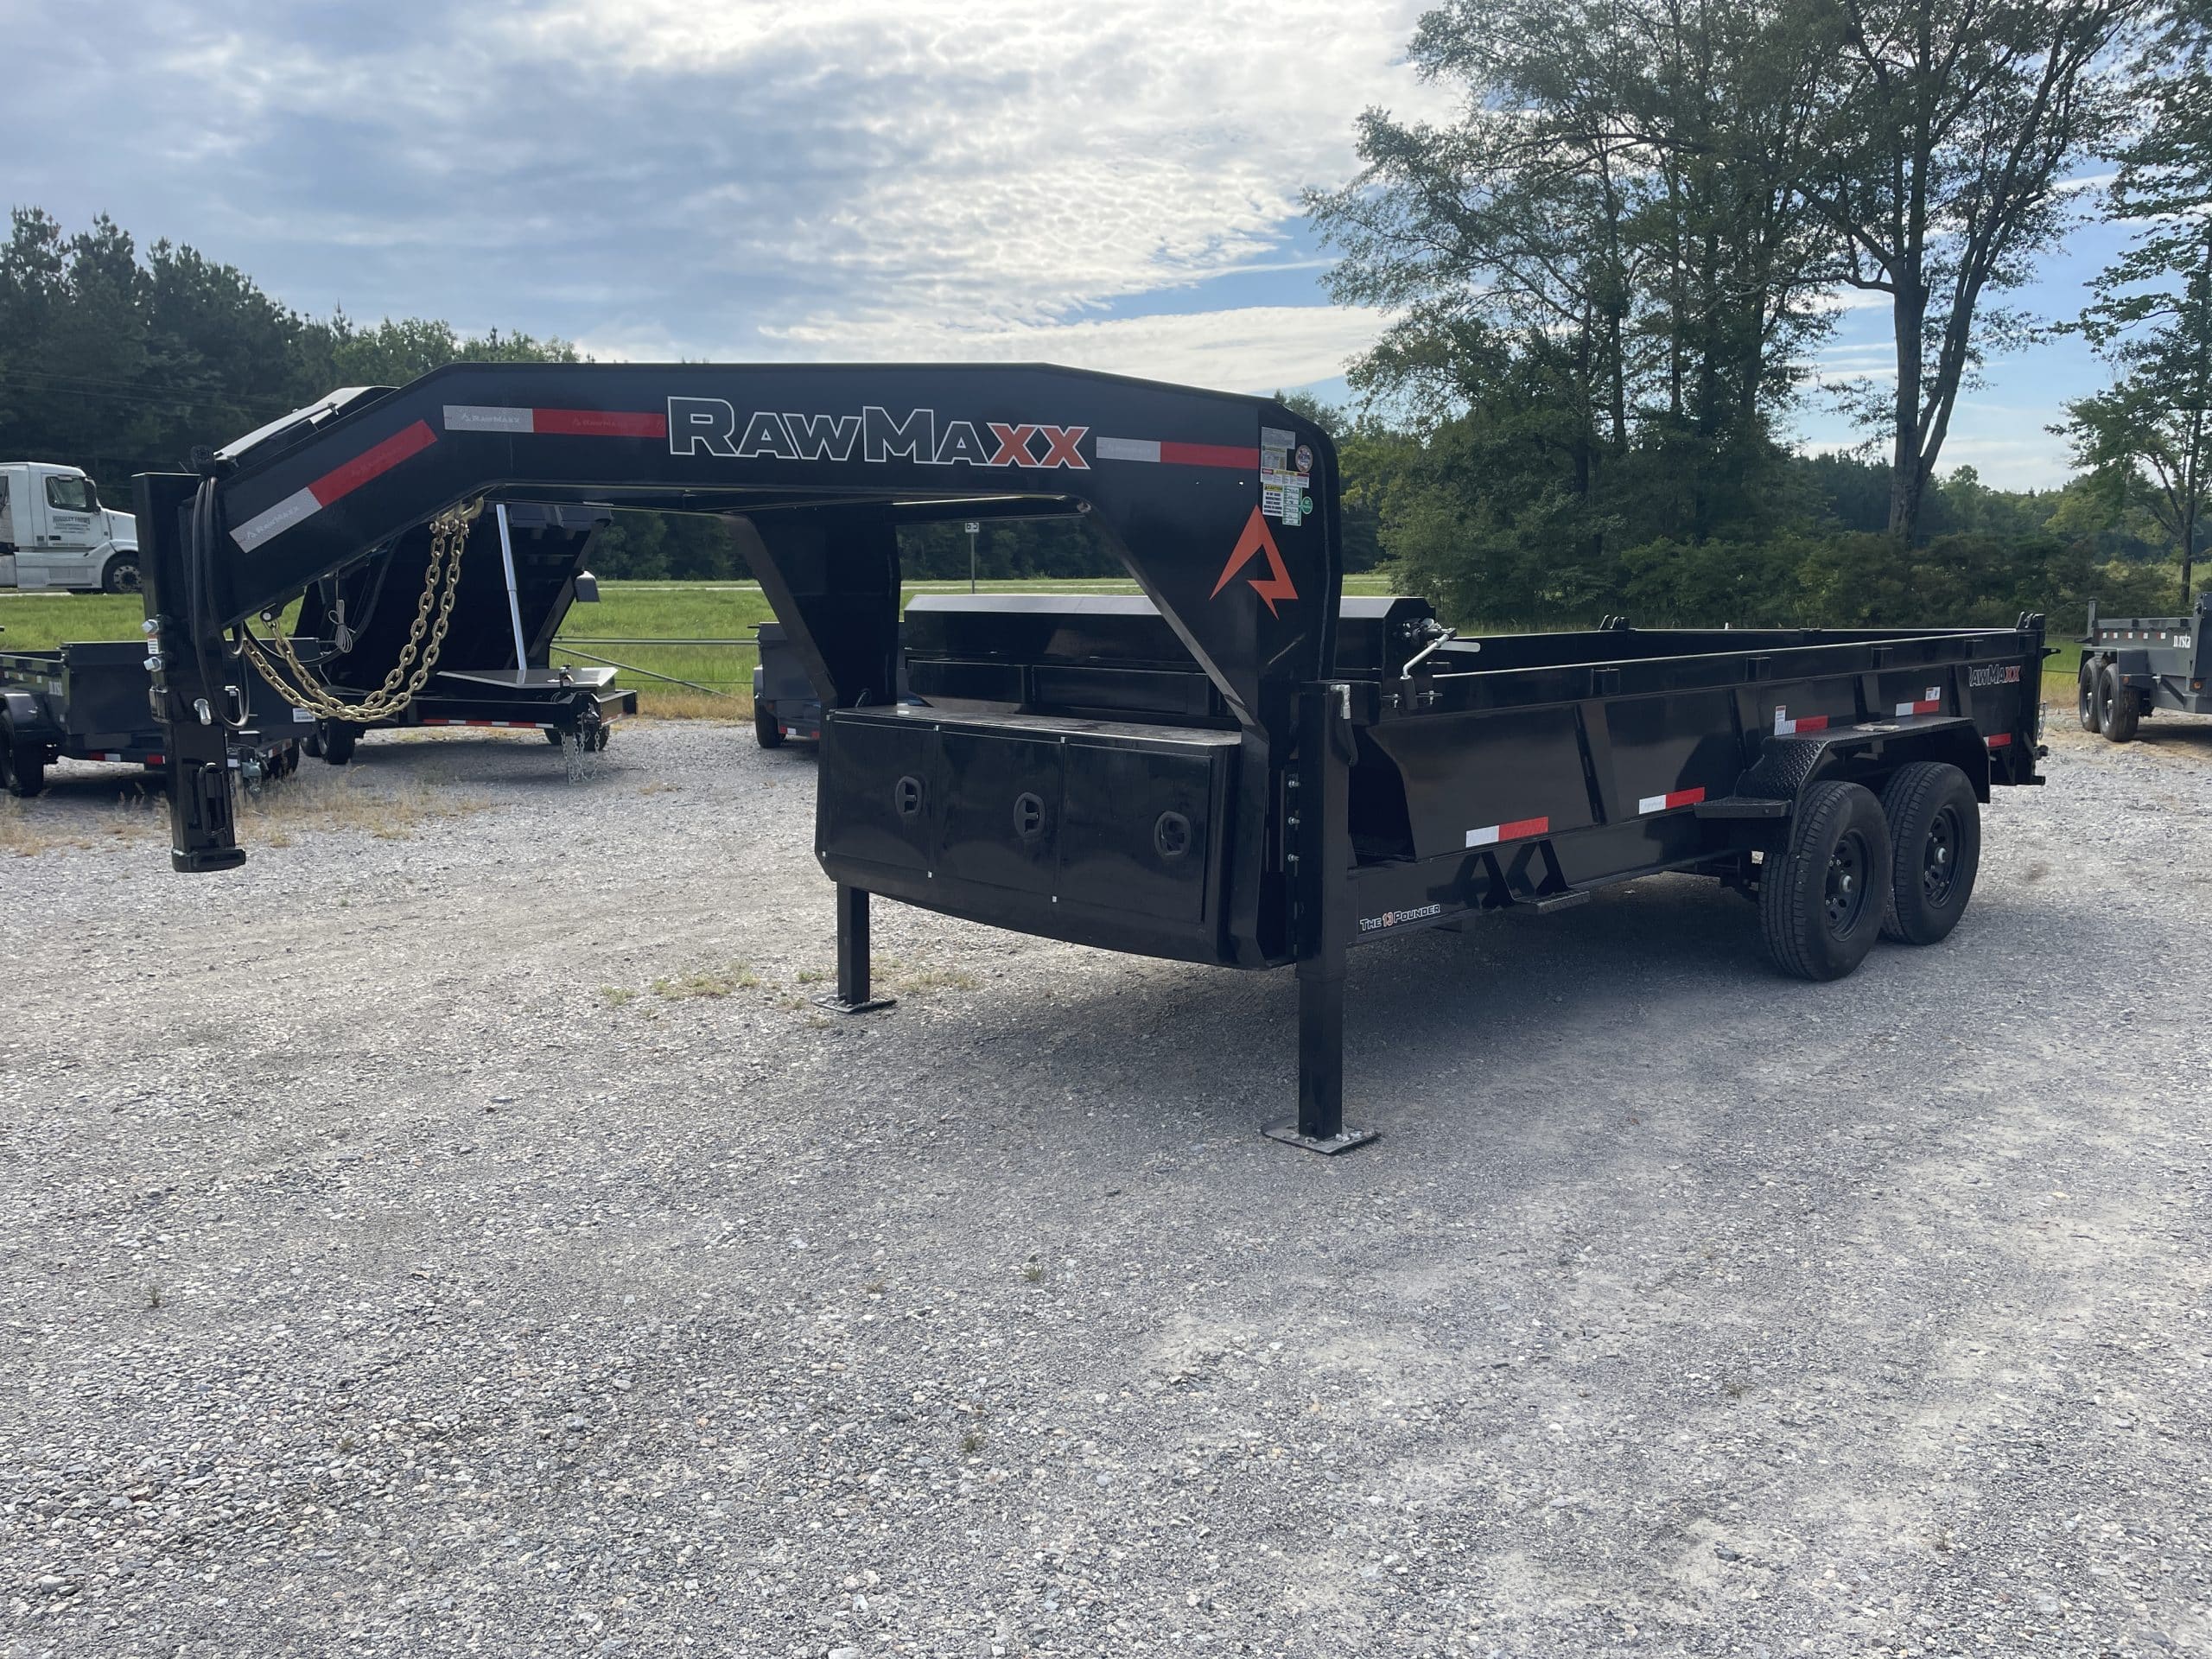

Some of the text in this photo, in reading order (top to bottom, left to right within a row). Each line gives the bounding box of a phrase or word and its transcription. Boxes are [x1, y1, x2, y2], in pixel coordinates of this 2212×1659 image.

[1968, 664, 2021, 687] AWMAXX
[1360, 917, 1382, 931] THE
[1394, 904, 1440, 924] POUNDER
